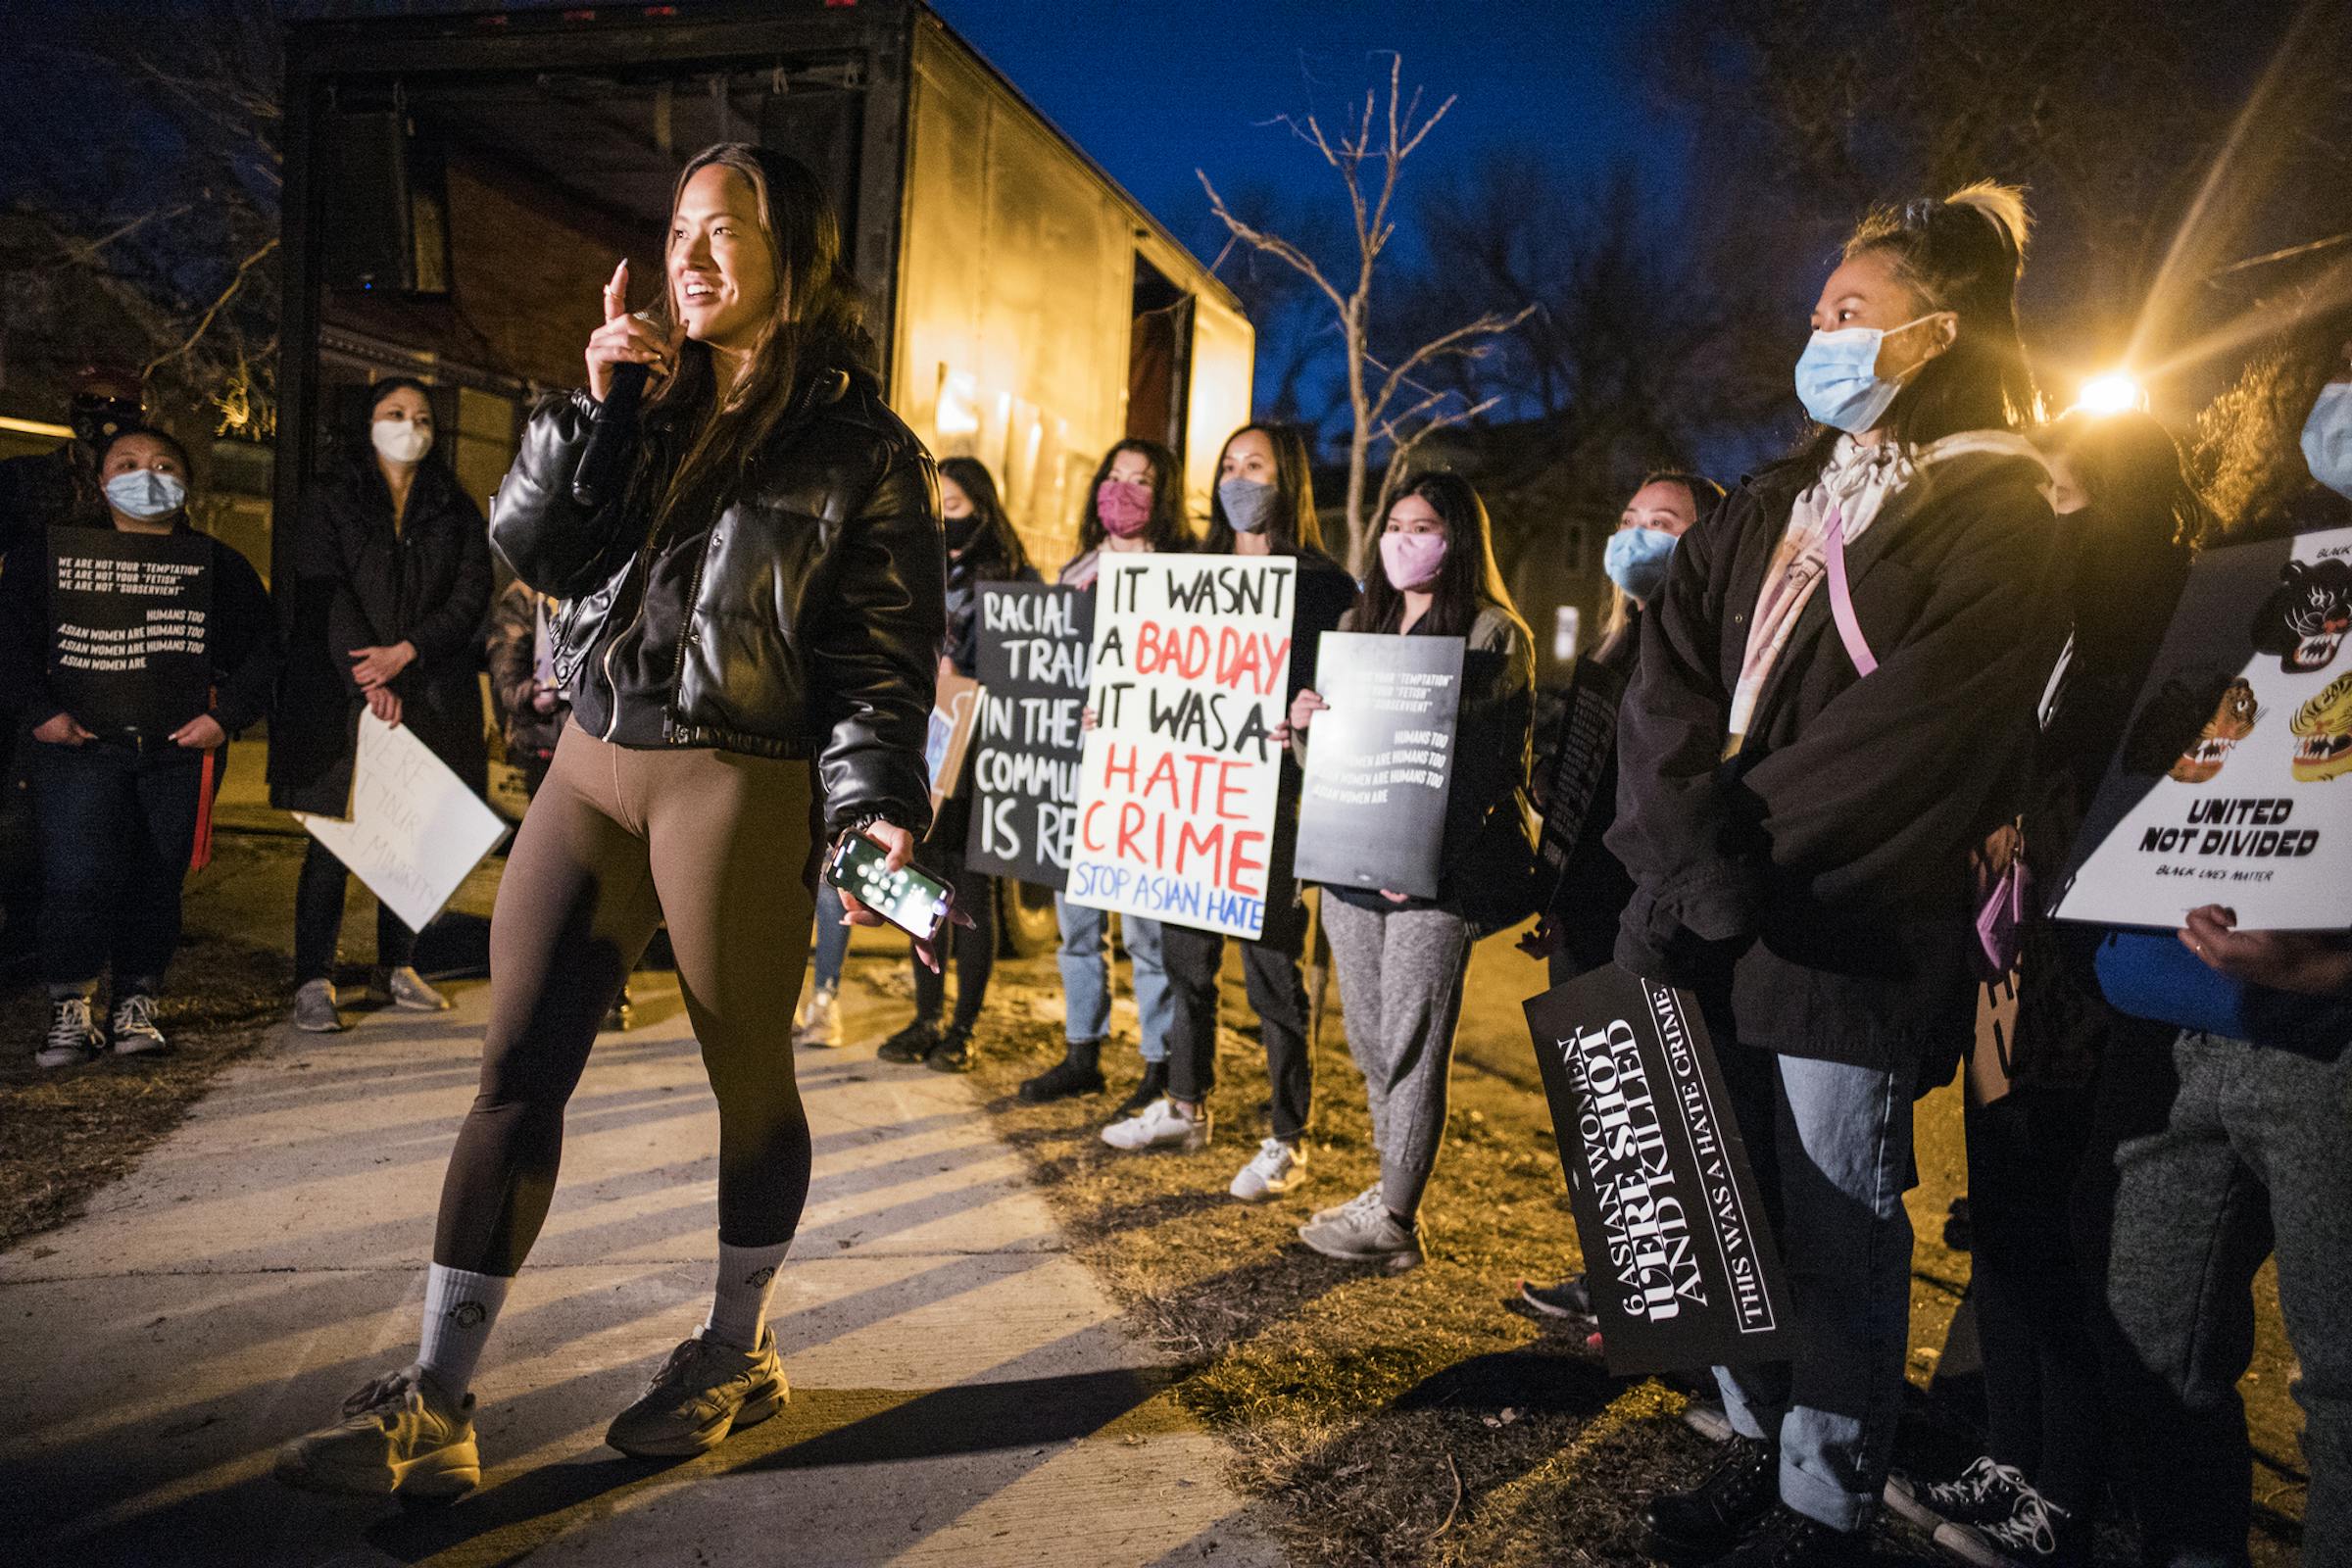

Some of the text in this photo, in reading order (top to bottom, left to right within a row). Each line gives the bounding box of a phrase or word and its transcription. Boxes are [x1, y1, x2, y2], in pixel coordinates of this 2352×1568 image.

[58, 557, 72, 567] WE
[74, 558, 92, 569] ARE
[95, 560, 115, 569] NOT
[116, 561, 140, 570] YOUR
[58, 568, 73, 579] WE
[74, 569, 92, 580] ARE
[95, 570, 115, 581] NOT
[116, 571, 140, 582] YOUR
[58, 579, 72, 590] WE
[74, 580, 92, 592] ARE
[95, 581, 115, 592] NOT
[1113, 566, 1150, 613] IT
[57, 623, 206, 641] ASIAN WOMEN ARE HUMANS TOO
[146, 609, 206, 624] HUMANS TOO
[983, 591, 1079, 638] RACIAL
[58, 639, 205, 657] ASIAN WOMEN ARE HUMANS TOO
[59, 655, 147, 671] ASIAN WOMEN ARE
[1097, 619, 1291, 696] A BAD DAY
[981, 694, 1013, 742] IN
[1019, 698, 1080, 749] THE
[1096, 682, 1270, 762] IT WAS A
[1394, 729, 1448, 749] HUMANS TOO
[1103, 742, 1253, 819] HATE
[1390, 769, 1427, 784] HUMANS
[1426, 771, 1445, 789] TOO
[1392, 749, 1430, 764] HUMANS
[1428, 751, 1446, 768] TOO
[982, 796, 1021, 860] IS
[2186, 798, 2294, 825] UNITED
[1082, 800, 1267, 896] CRIME
[2138, 827, 2320, 858] NOT DIVIDED
[1074, 861, 1265, 931] STOP ASIAN HATE
[2155, 864, 2196, 876] BLACK
[2230, 869, 2275, 882] MATTER
[1682, 1081, 1716, 1155] HATE
[1557, 1037, 1645, 1316] 6 ASIAN WOMEN
[1576, 1025, 1680, 1323] WERE SHOT
[1607, 1018, 1708, 1307] AND KILLED
[1707, 1158, 1725, 1180] A
[1712, 1186, 1742, 1252] WAS
[1732, 1256, 1763, 1324] THIS
